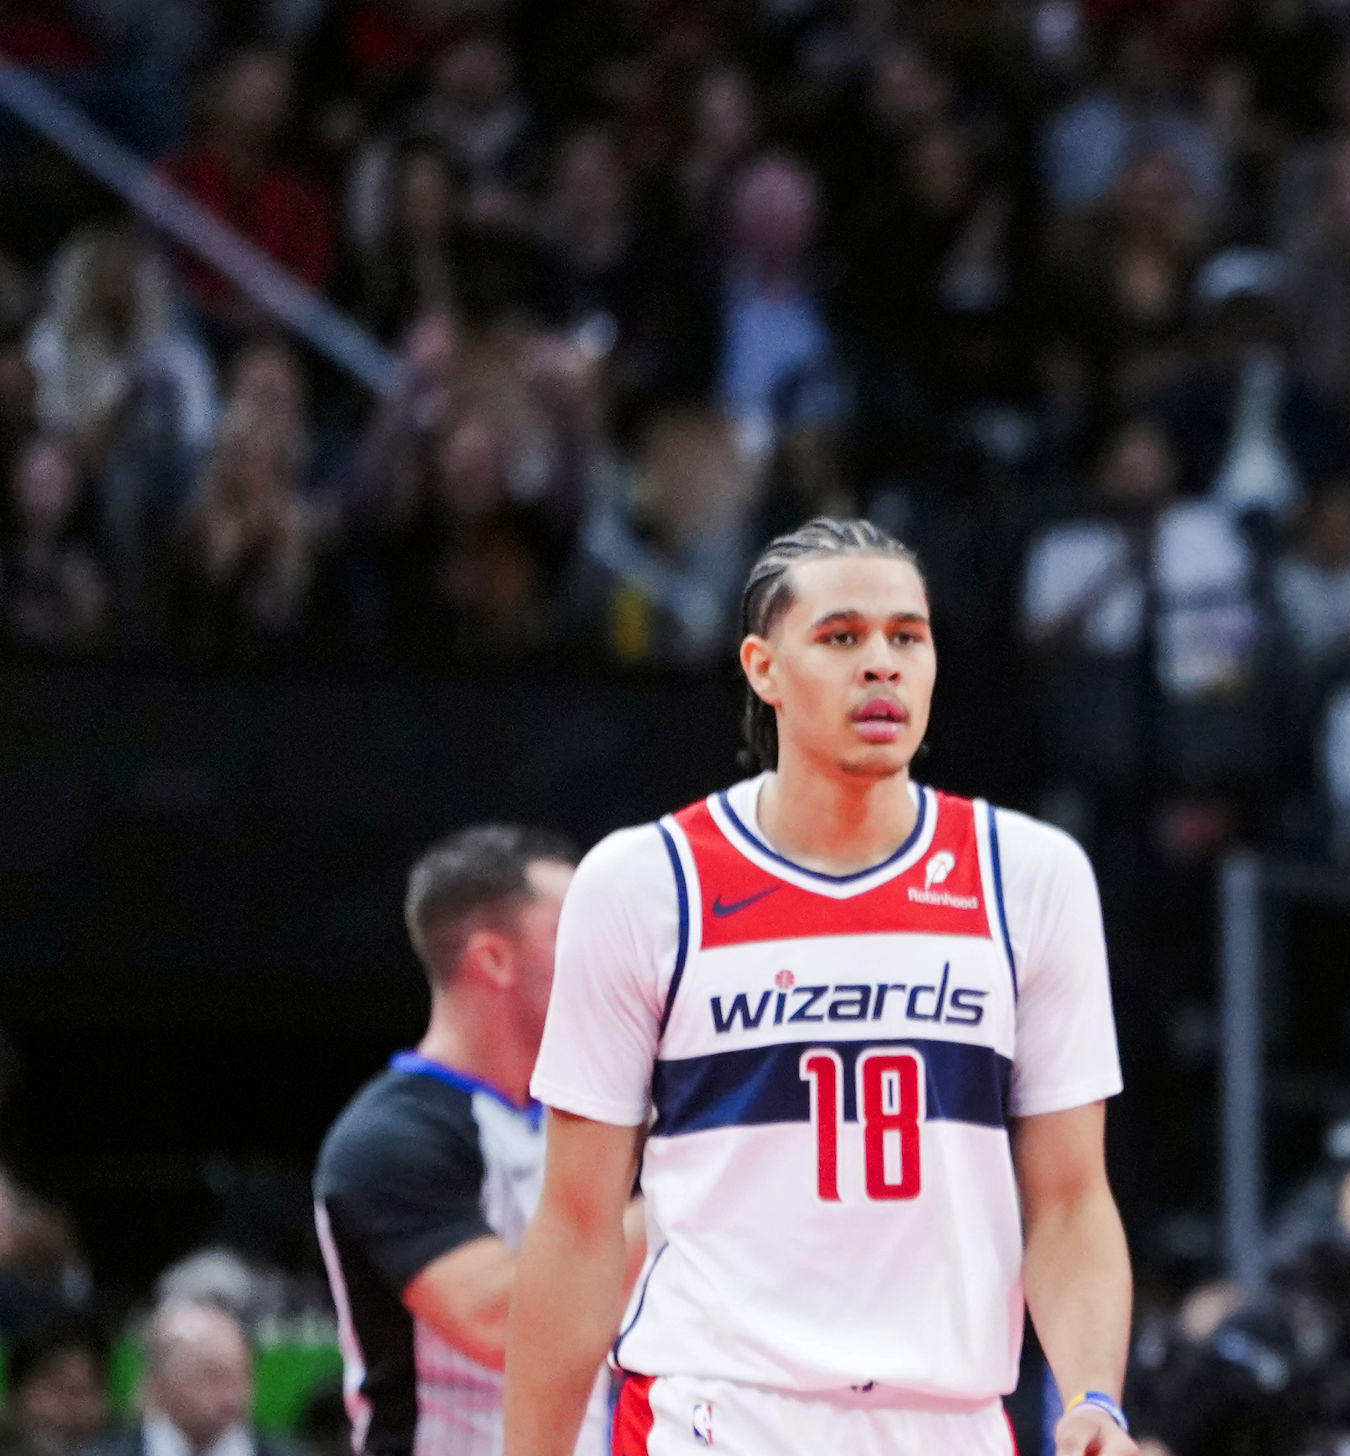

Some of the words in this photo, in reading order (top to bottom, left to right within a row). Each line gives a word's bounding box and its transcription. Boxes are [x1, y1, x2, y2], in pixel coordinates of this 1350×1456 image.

[907, 886, 979, 910] Robinhood
[709, 960, 989, 1035] wizards
[799, 1046, 926, 1203] 18
